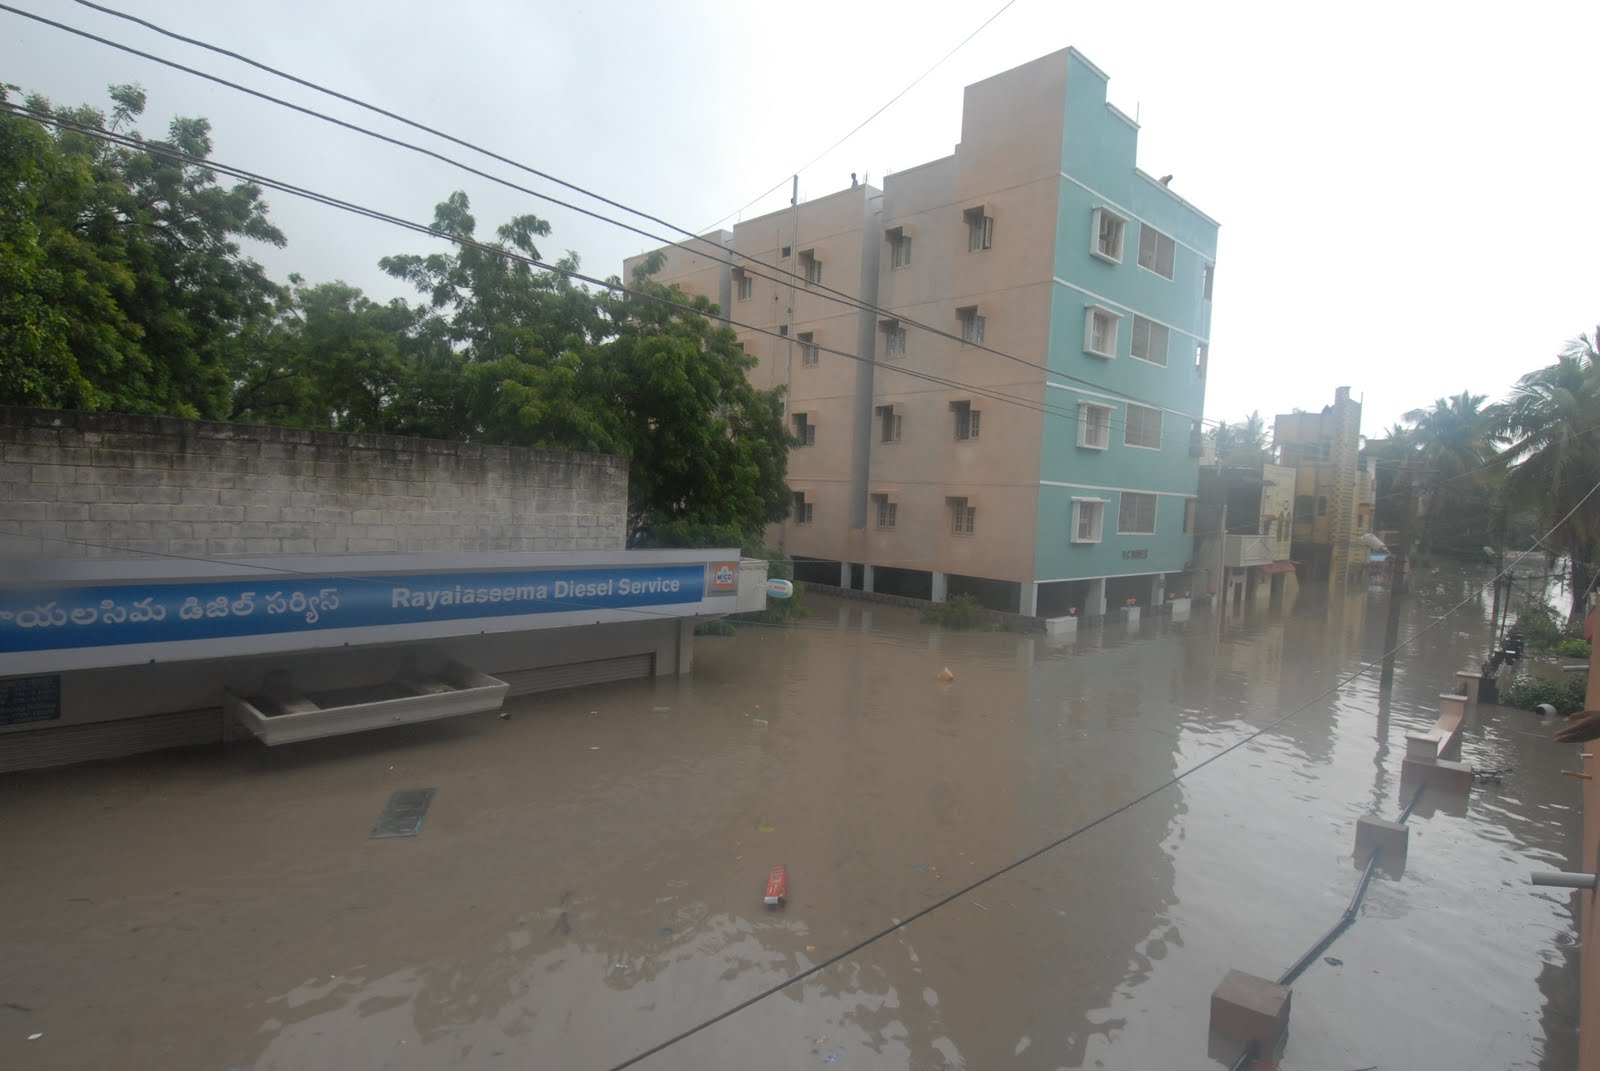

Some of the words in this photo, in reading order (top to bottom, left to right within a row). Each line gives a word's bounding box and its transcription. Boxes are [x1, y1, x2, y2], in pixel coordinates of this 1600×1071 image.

[391, 584, 548, 611] Rayalaseema
[554, 579, 613, 598] Diesel
[618, 577, 680, 595] Service
